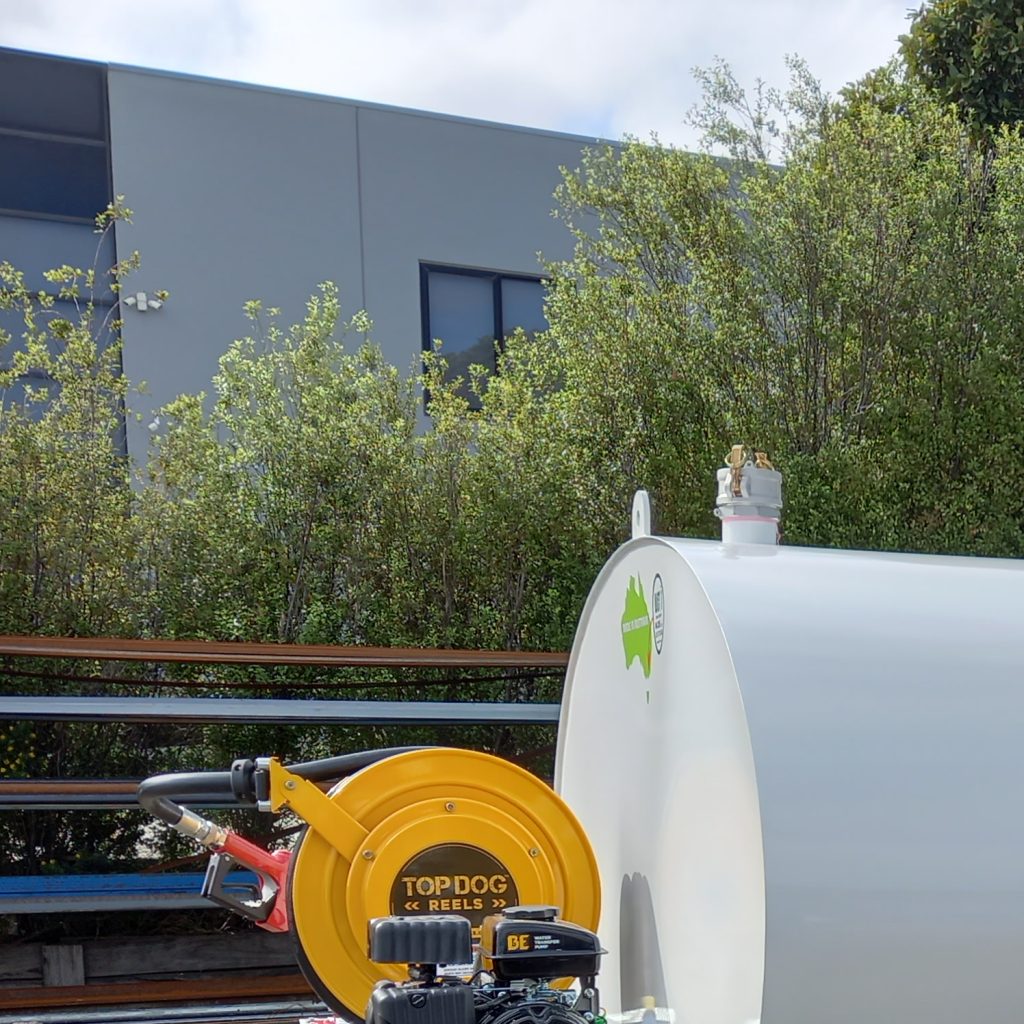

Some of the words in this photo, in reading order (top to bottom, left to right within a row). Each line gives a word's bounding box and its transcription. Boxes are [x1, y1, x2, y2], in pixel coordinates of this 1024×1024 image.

[402, 875, 451, 897] TOP
[454, 874, 508, 895] DOG
[428, 898, 483, 911] REELS
[507, 934, 530, 951] BE
